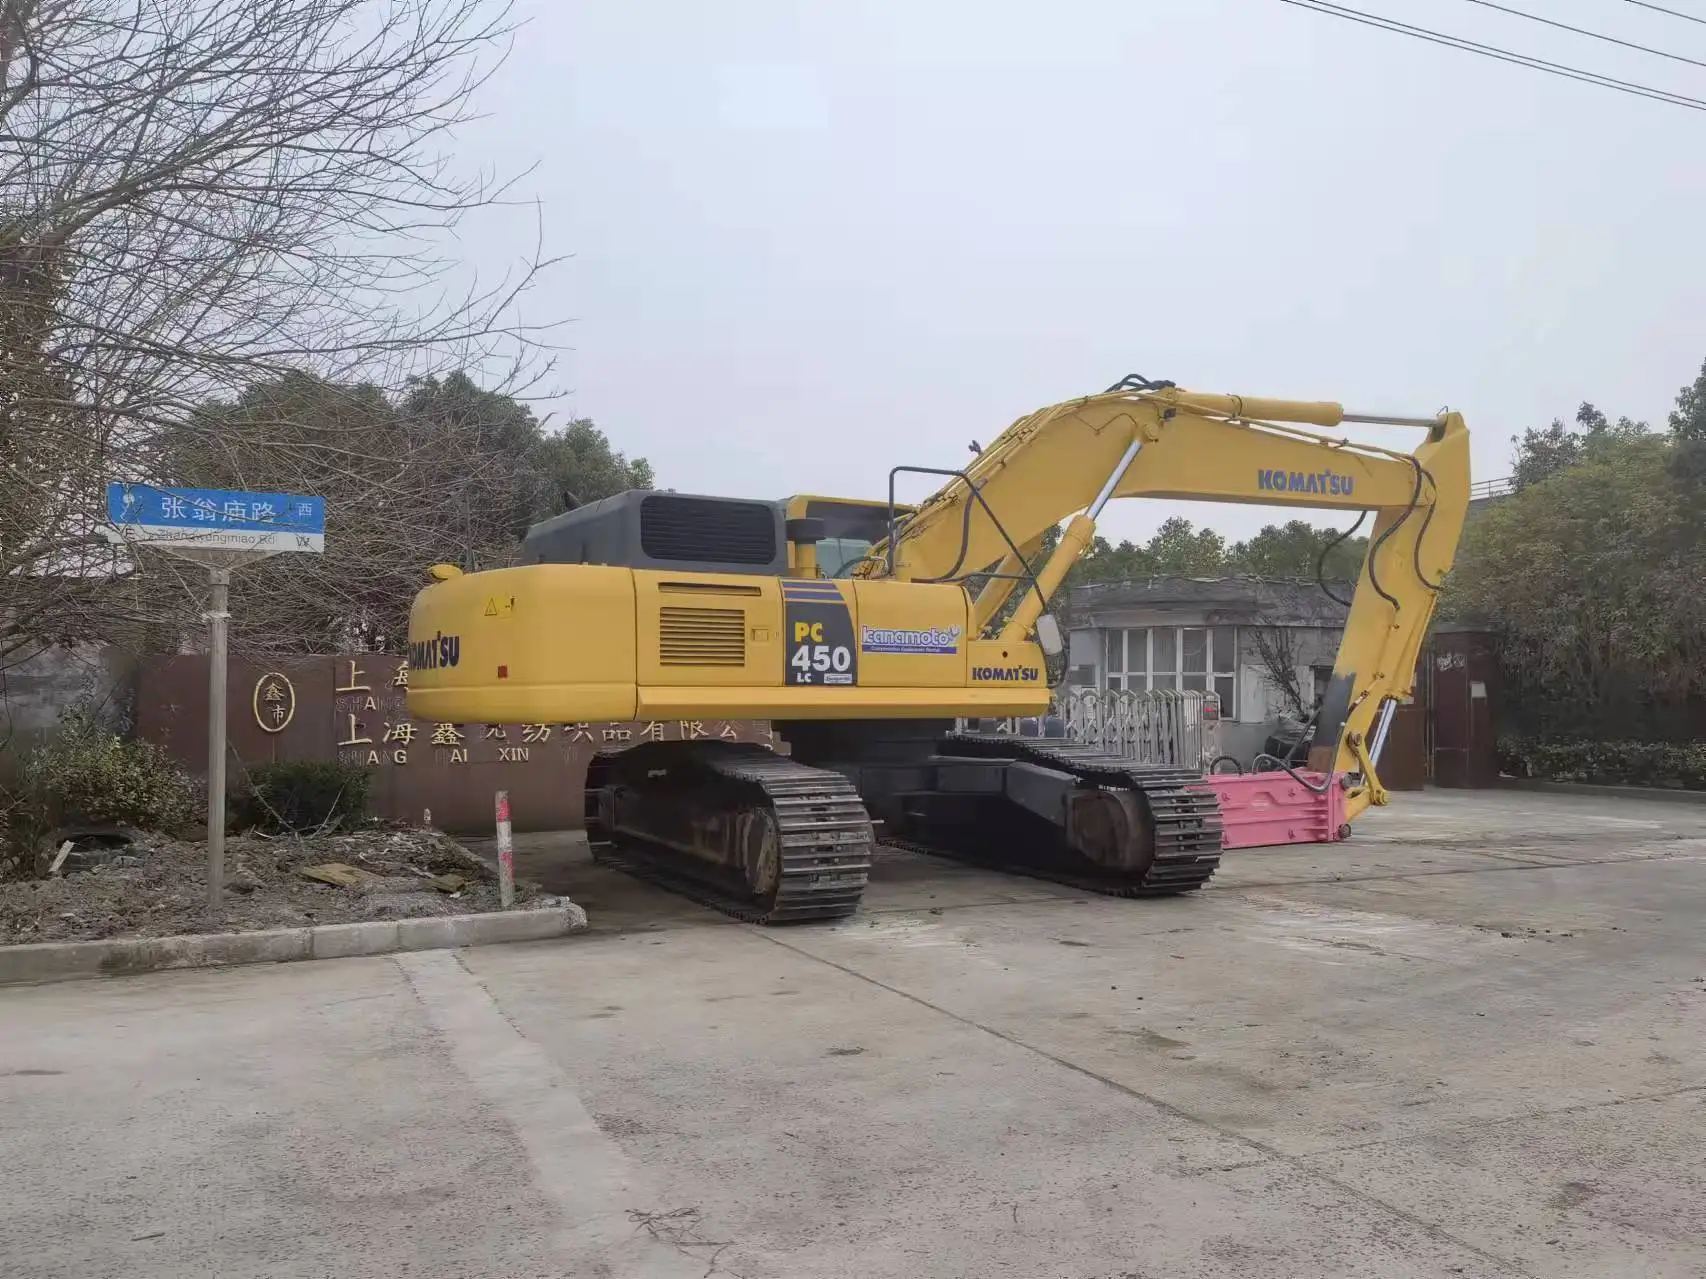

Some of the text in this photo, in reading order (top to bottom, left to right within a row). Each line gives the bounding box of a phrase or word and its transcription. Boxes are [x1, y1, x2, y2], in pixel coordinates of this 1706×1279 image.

[1258, 468, 1354, 496] KOMATSU
[161, 497, 313, 524] 张翁庙路 西
[794, 622, 824, 643] PC
[408, 630, 460, 670] OMATSU
[791, 645, 851, 673] 450
[796, 672, 812, 683] LC
[972, 665, 1039, 682] KOMATSU
[499, 748, 529, 762] XIN
